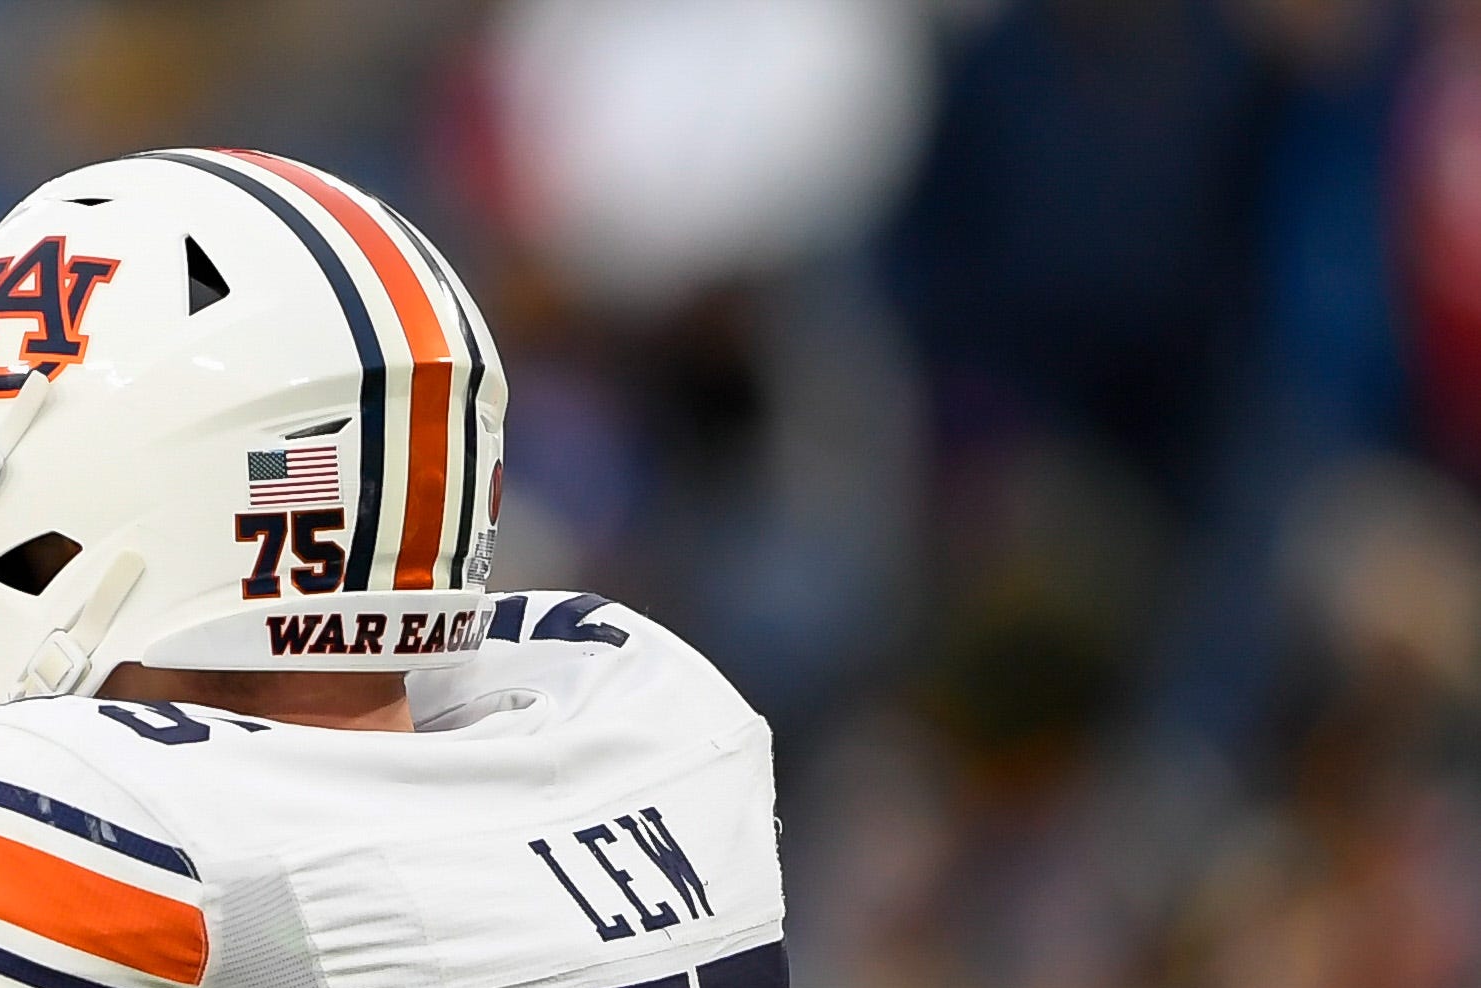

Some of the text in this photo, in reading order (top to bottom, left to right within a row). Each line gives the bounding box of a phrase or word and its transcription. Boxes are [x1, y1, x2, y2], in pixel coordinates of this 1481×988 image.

[235, 507, 345, 600] 75
[266, 613, 387, 656] WAR
[528, 807, 714, 942] LEW
